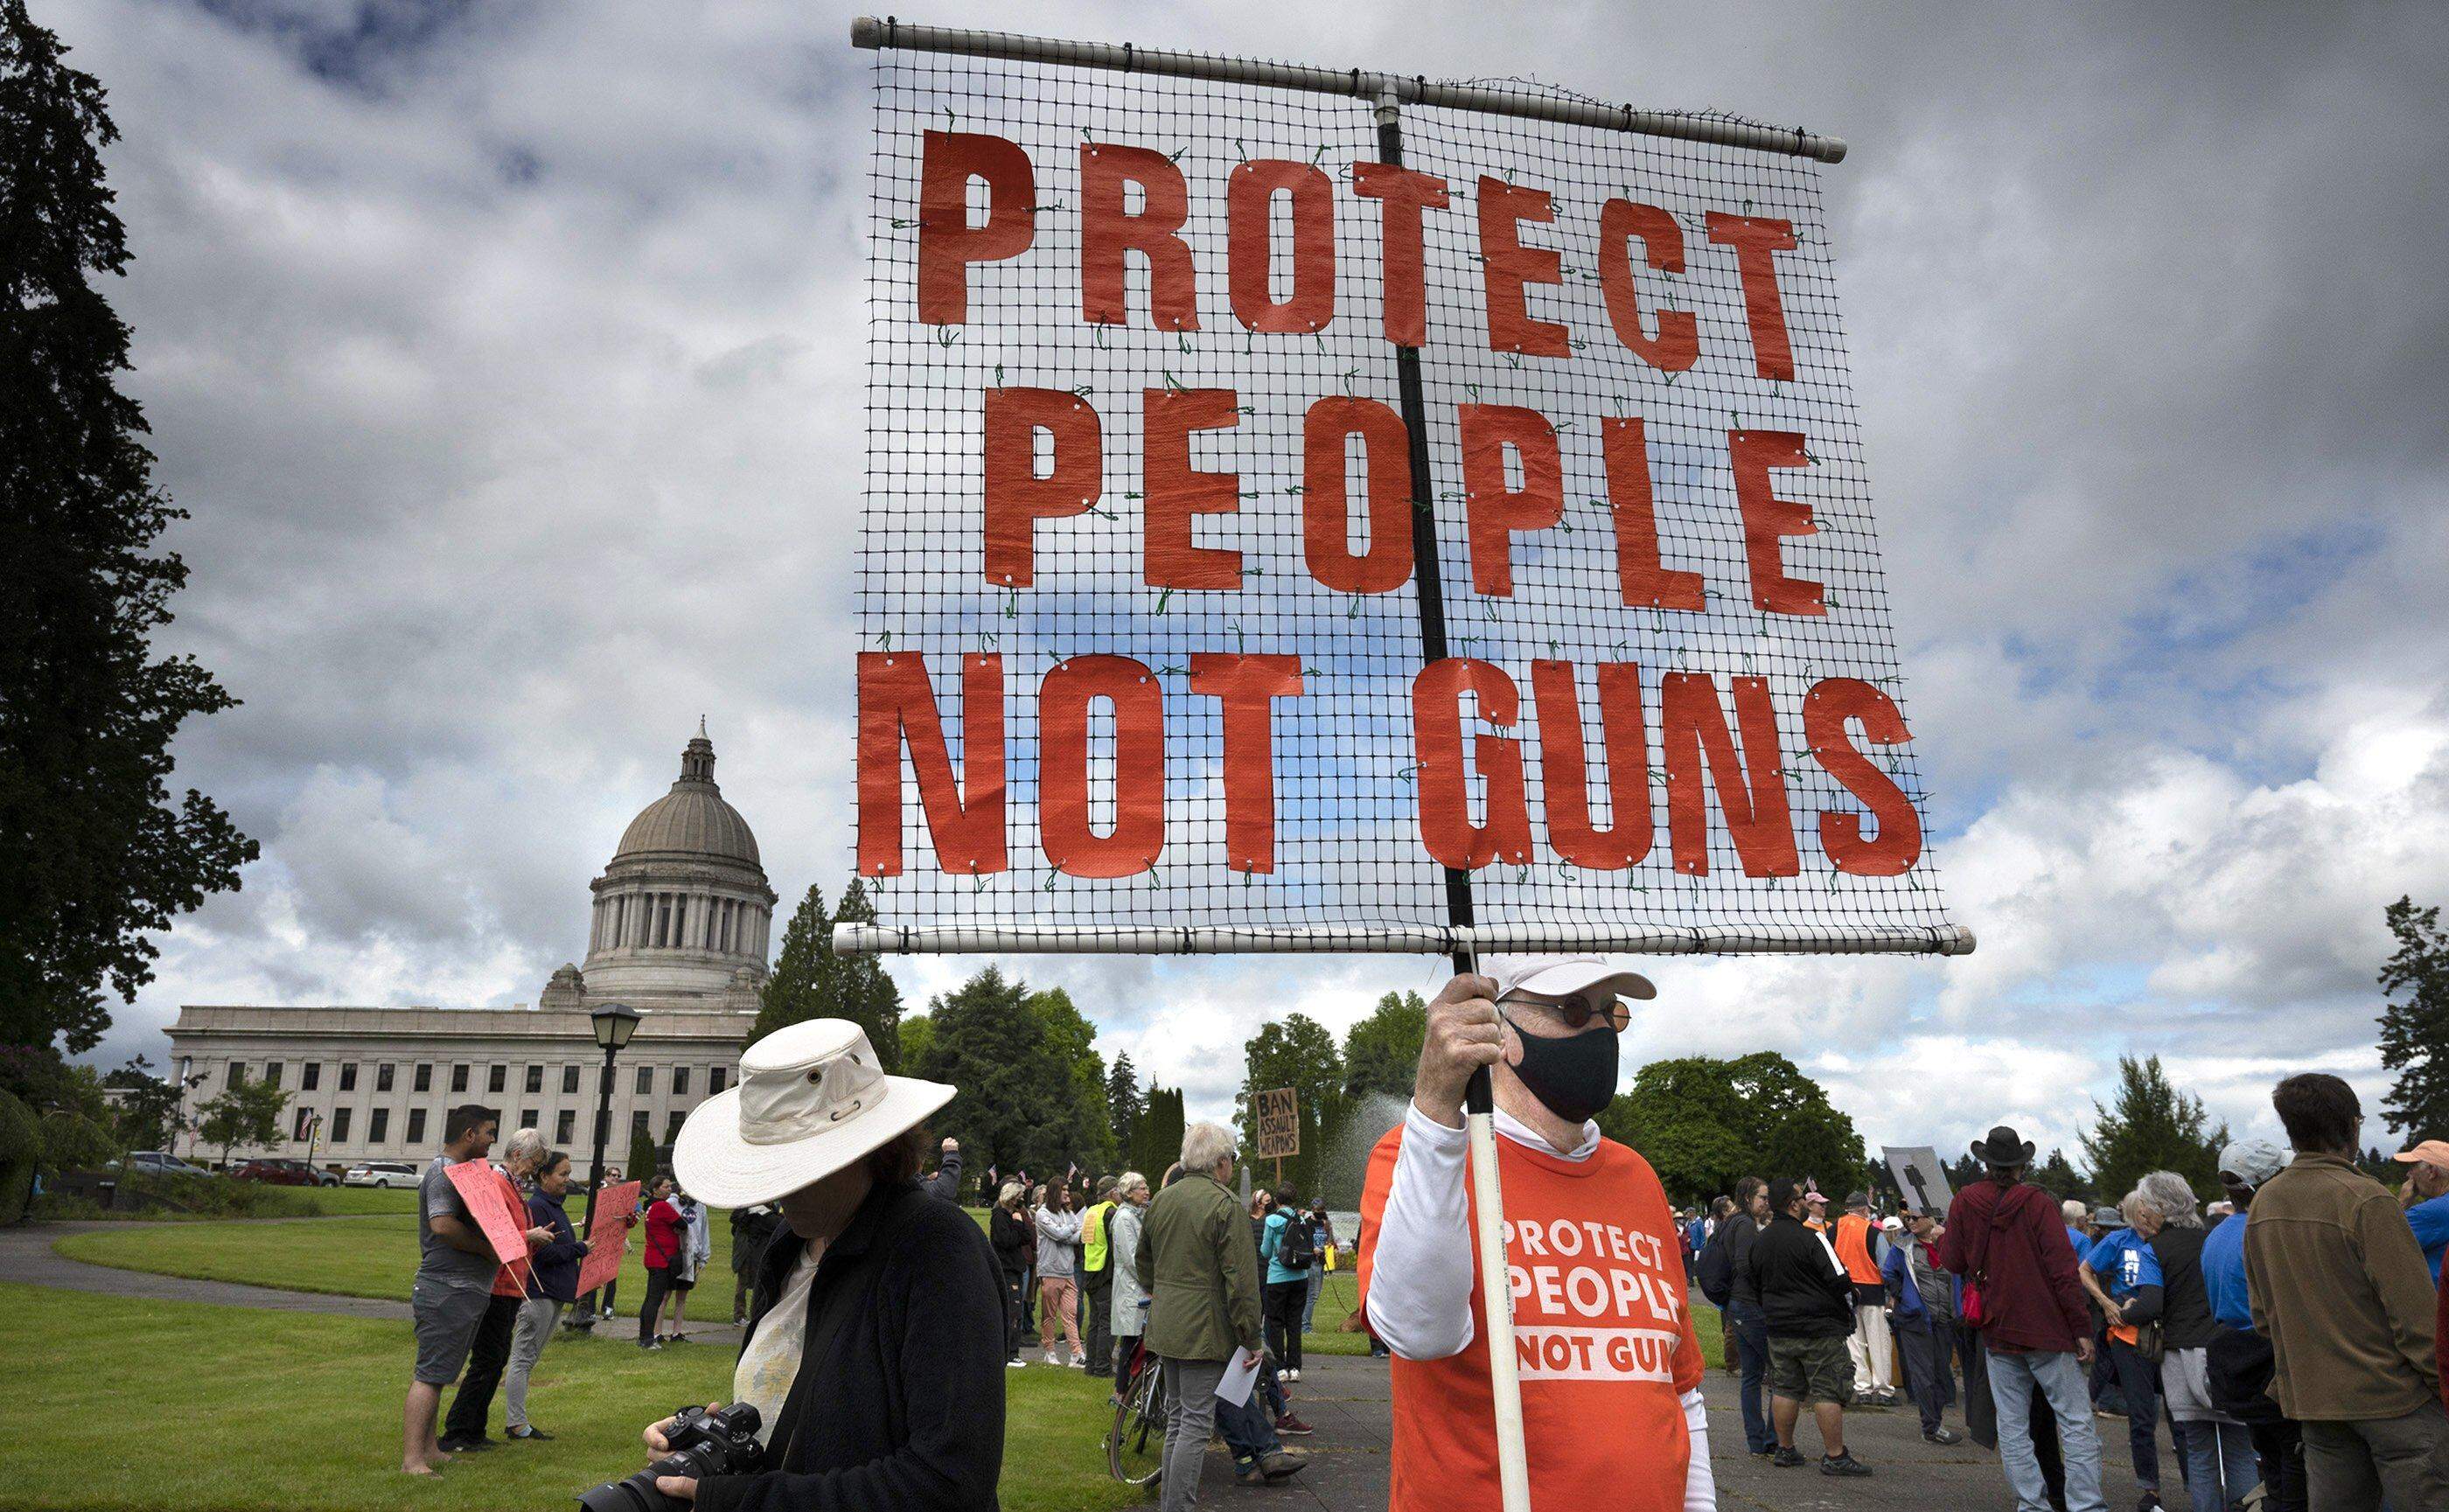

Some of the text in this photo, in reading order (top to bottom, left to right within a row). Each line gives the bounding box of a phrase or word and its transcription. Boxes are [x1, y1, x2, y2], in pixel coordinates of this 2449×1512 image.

[918, 129, 1797, 381] PROTECT
[985, 387, 1828, 617] PEOPLE
[857, 651, 1922, 878] NOT GUNS
[1259, 1092, 1294, 1117] BAN
[1259, 1115, 1295, 1136] ASSAULT
[1260, 1134, 1296, 1154] WEAPONS
[1504, 1219, 1663, 1272] PROTECT
[1515, 1334, 1594, 1371] NOT
